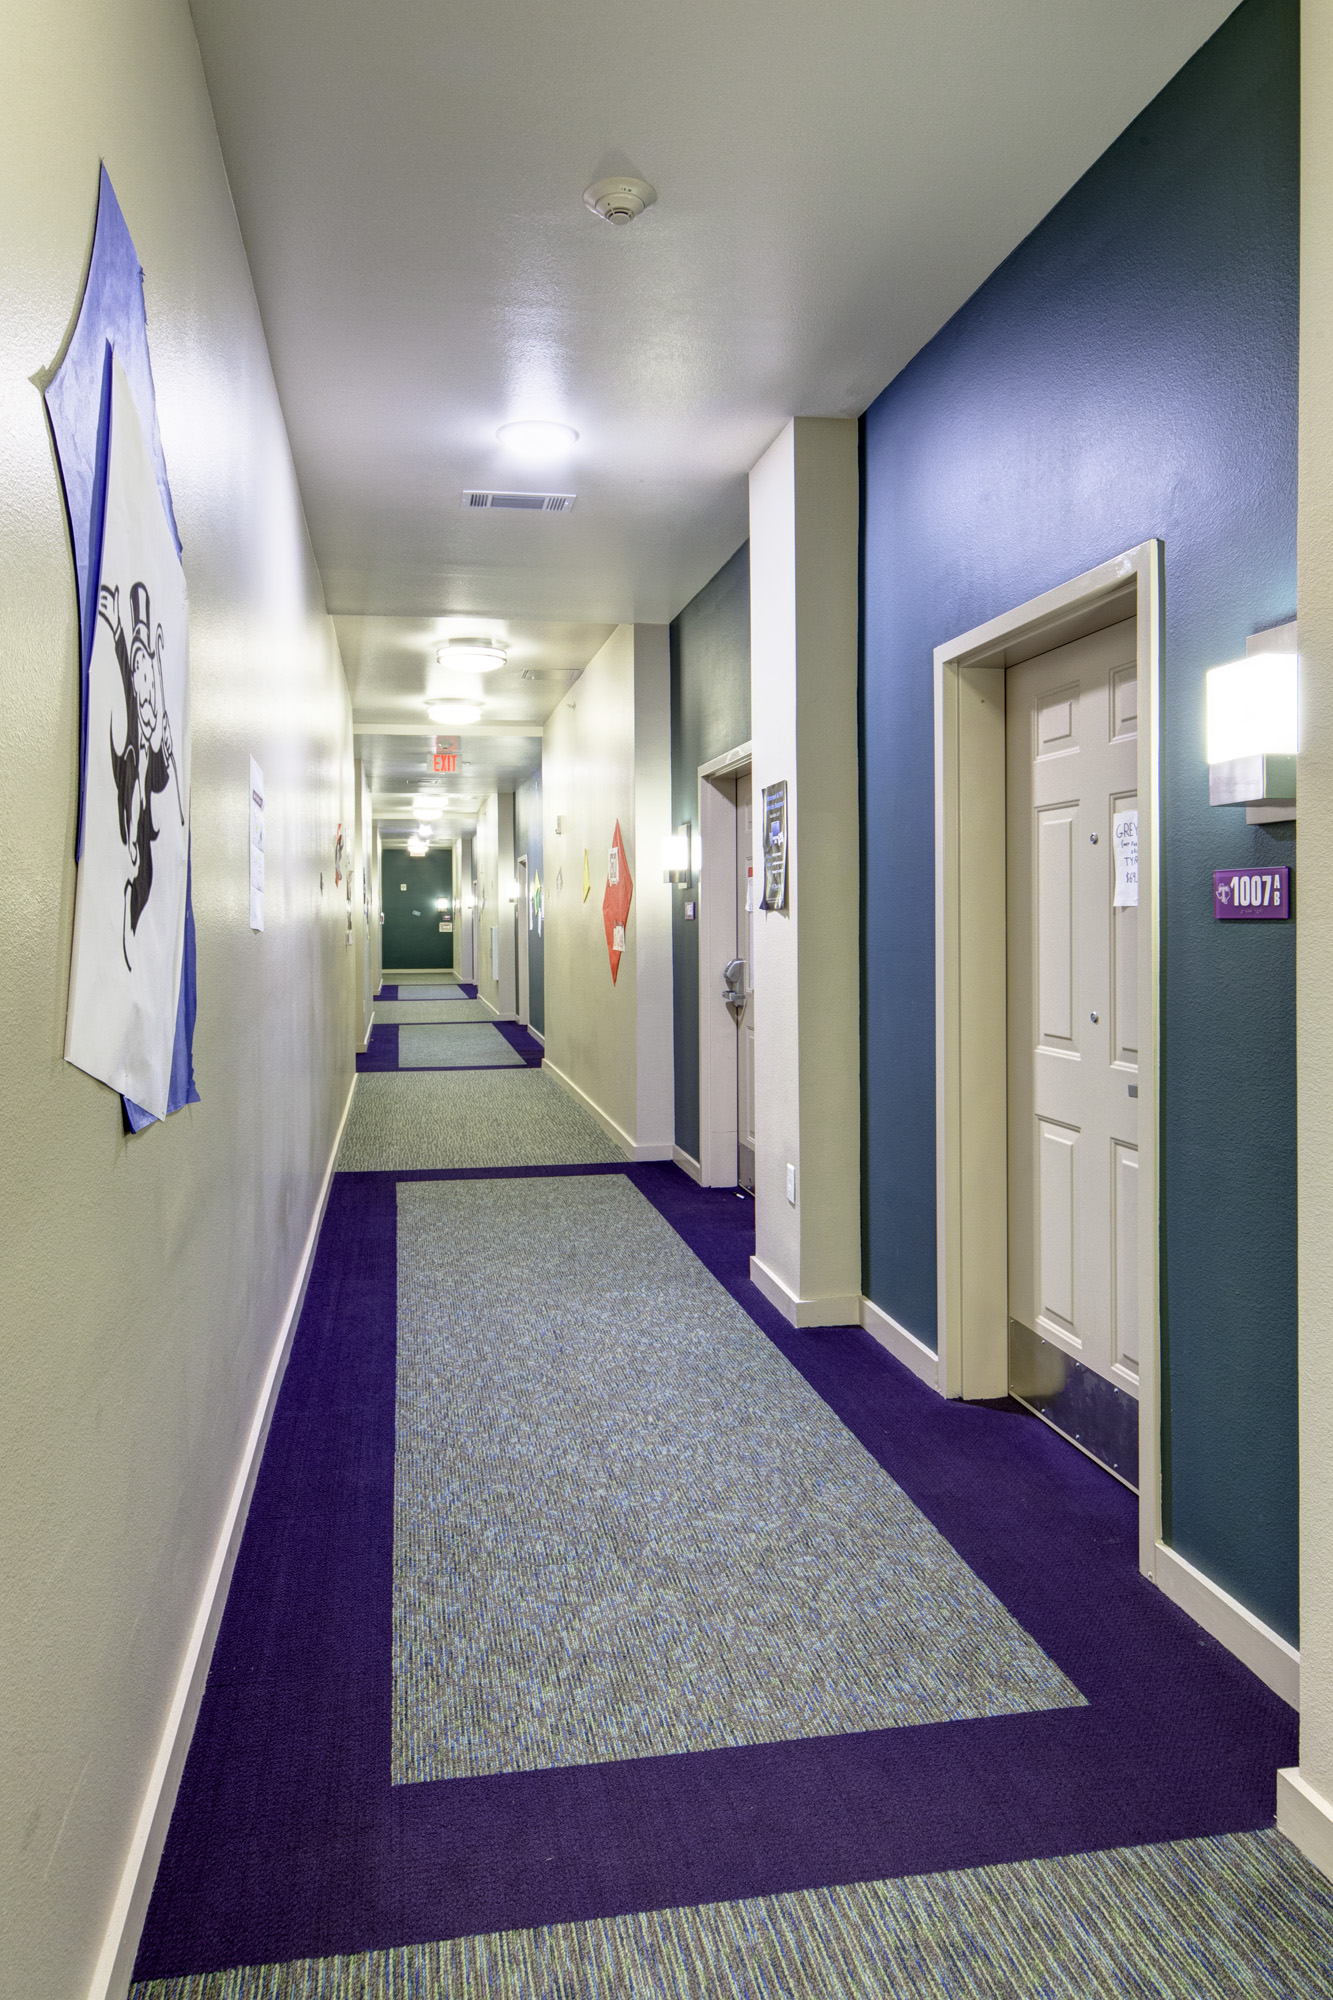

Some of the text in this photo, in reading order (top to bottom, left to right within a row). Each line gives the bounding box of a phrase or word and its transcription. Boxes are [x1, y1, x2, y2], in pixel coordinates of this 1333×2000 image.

[433, 754, 457, 772] EXIT
[1274, 874, 1280, 888] A
[1230, 875, 1272, 906] 1007
[1274, 891, 1280, 905] B
